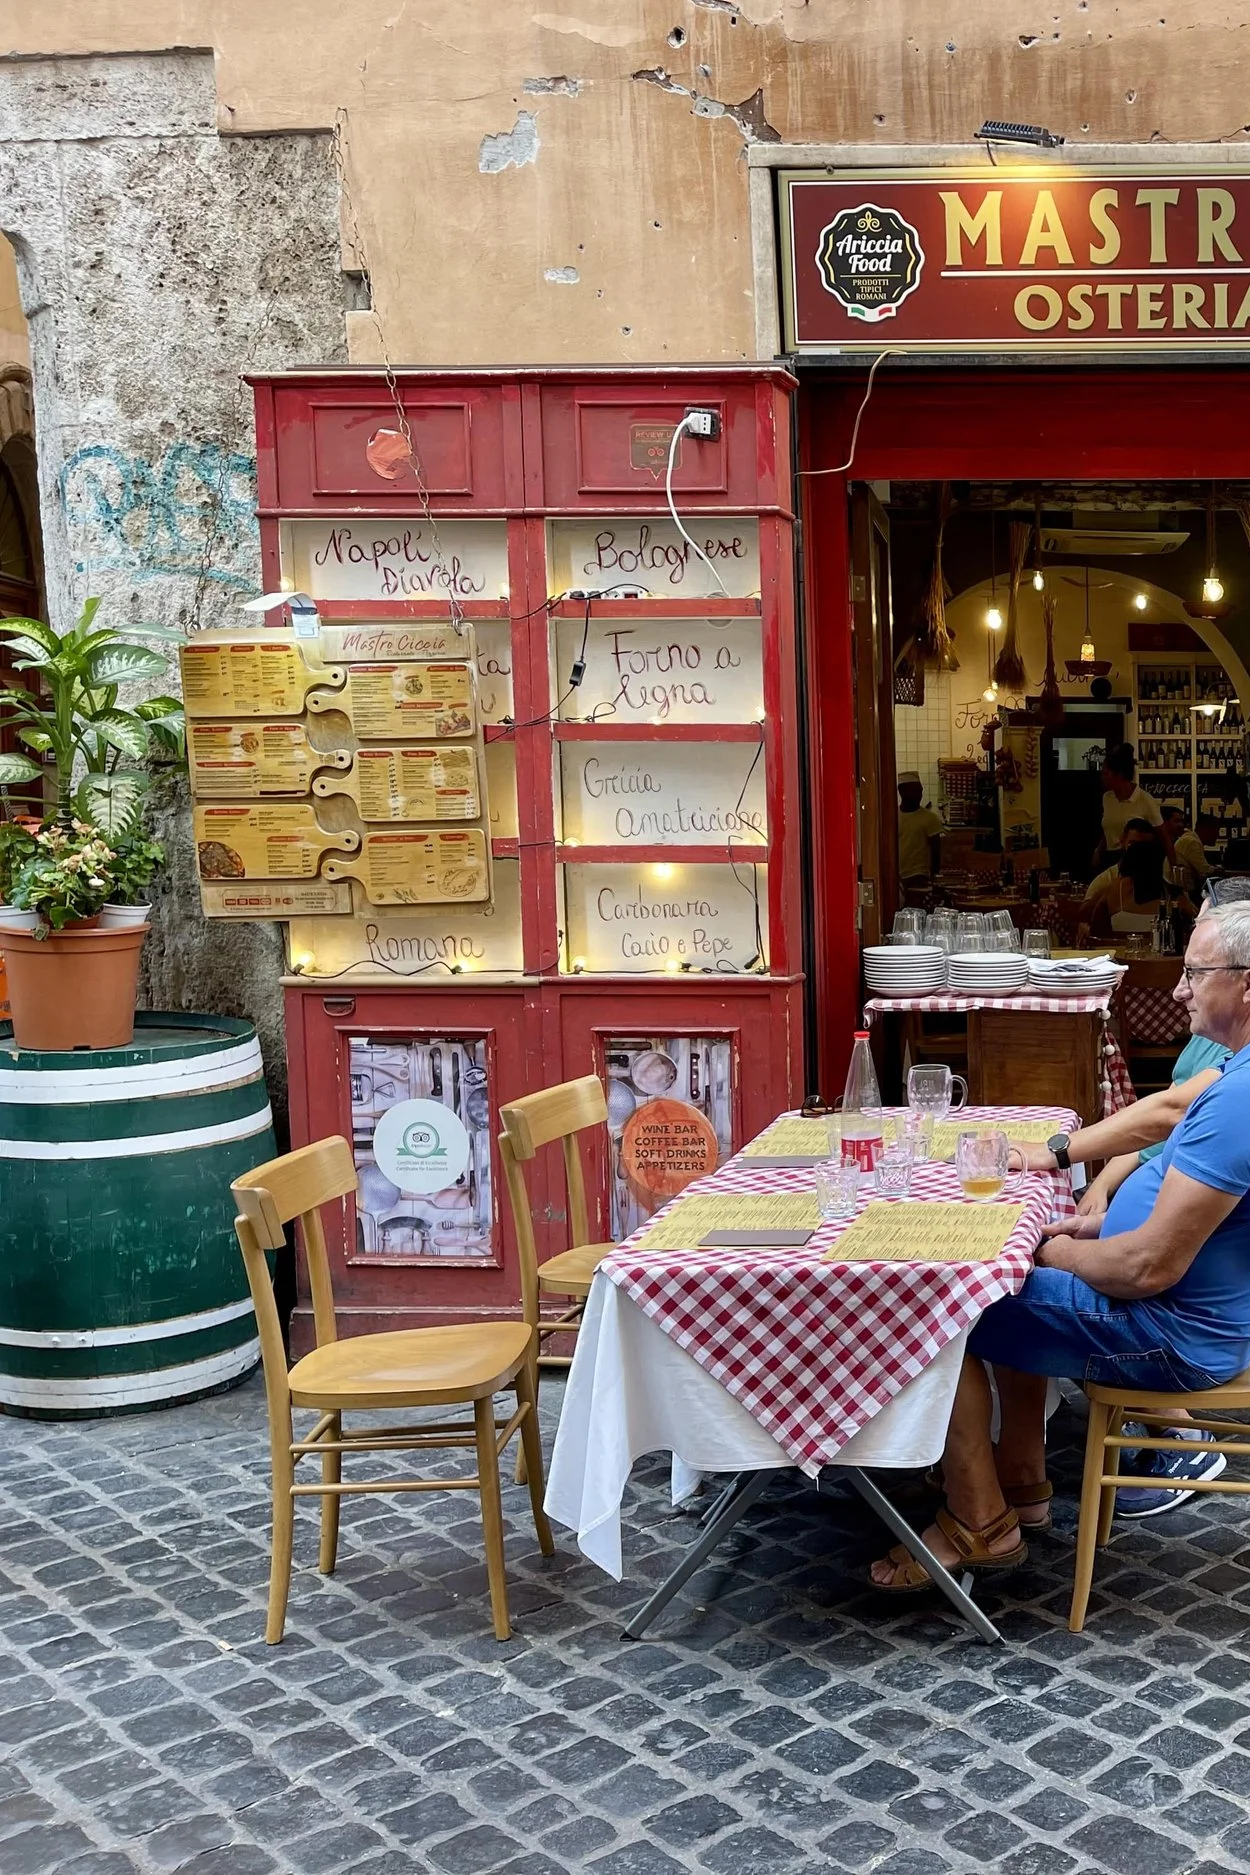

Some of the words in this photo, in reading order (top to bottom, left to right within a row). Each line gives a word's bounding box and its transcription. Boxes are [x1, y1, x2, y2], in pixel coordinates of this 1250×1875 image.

[836, 234, 903, 256] Ariccia
[848, 254, 892, 273] Food
[856, 293, 887, 301] ROMANI
[314, 527, 431, 566] Napoli
[583, 524, 747, 585] Bolognese
[380, 556, 486, 595] Diavola
[342, 631, 393, 658] Mastro
[604, 628, 703, 675] Forno
[714, 645, 741, 671] a
[597, 884, 719, 922] Carbonara
[365, 924, 485, 961] Romana
[621, 931, 671, 959] Cacio
[677, 937, 687, 954] e
[692, 928, 734, 960] Pepe
[634, 1137, 678, 1146] COFFEE
[682, 1137, 706, 1146] BAR
[641, 1125, 671, 1134] WINE
[674, 1125, 698, 1134] BAR
[635, 1149, 662, 1159] SOFT
[666, 1149, 706, 1158] DRINKS
[637, 1161, 705, 1171] APPETIZERS
